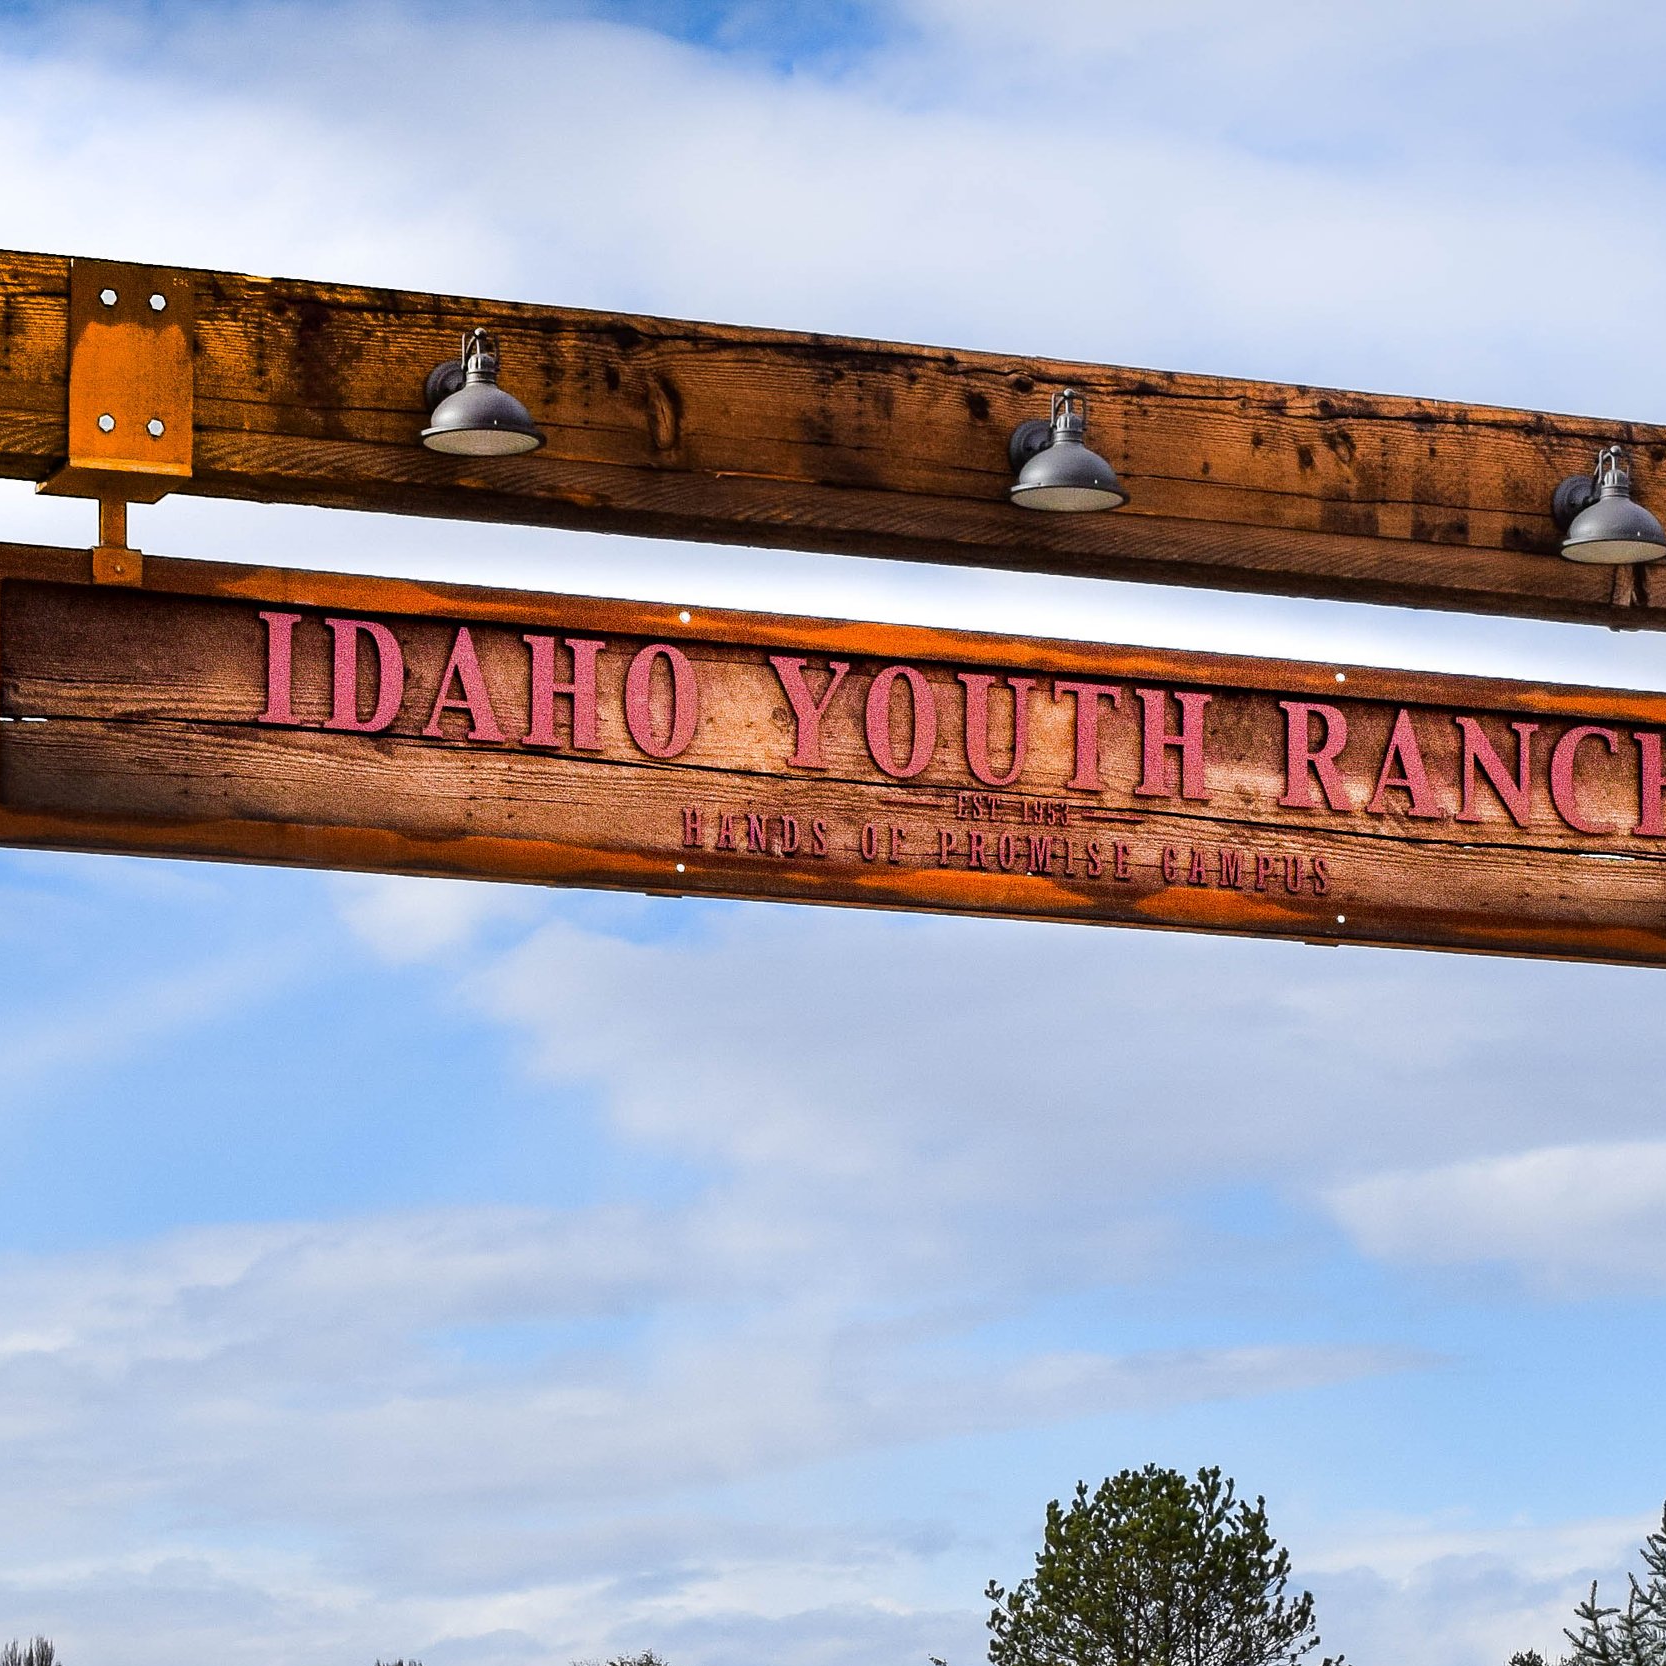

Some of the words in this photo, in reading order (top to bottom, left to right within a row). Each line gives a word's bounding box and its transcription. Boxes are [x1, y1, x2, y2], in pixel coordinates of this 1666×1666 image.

[258, 611, 698, 758] IDAHO
[768, 655, 1213, 800] YOUTH
[682, 807, 829, 857] HANDS
[861, 822, 907, 862] OF
[938, 828, 1132, 881] PROMISE
[1162, 844, 1331, 894] CAMPUS
[1022, 800, 1070, 826] 1953
